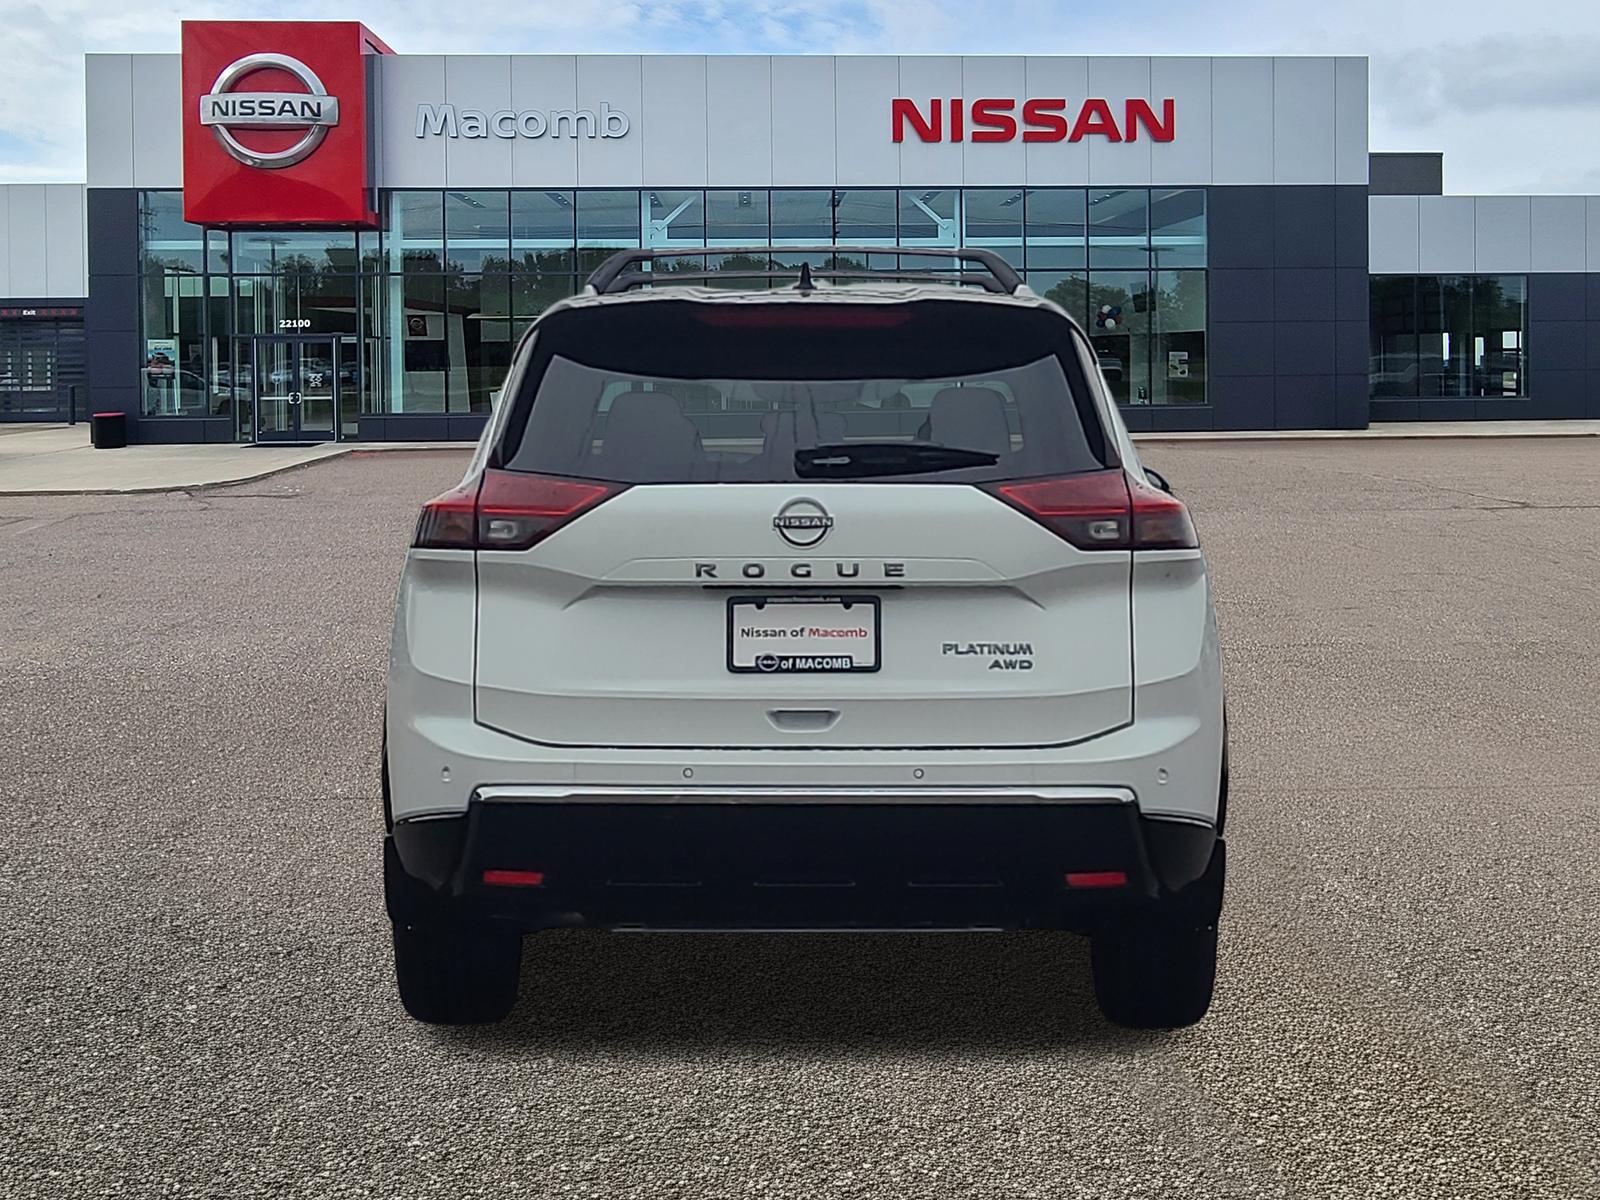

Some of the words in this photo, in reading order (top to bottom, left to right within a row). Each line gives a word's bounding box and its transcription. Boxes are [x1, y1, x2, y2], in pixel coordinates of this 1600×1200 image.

[211, 99, 322, 118] NISSAN
[415, 102, 631, 139] Macomb
[892, 98, 1175, 142] NISSAN
[279, 319, 311, 328] 22100
[774, 518, 832, 526] NISSAN
[695, 562, 905, 579] ROGUE
[740, 627, 786, 638] Nissan
[790, 627, 805, 638] of
[808, 627, 868, 638] Macomb
[942, 643, 1033, 655] PLATINUM
[780, 657, 794, 669] of
[795, 657, 851, 669] MACOMB
[988, 659, 1033, 670] AWD
